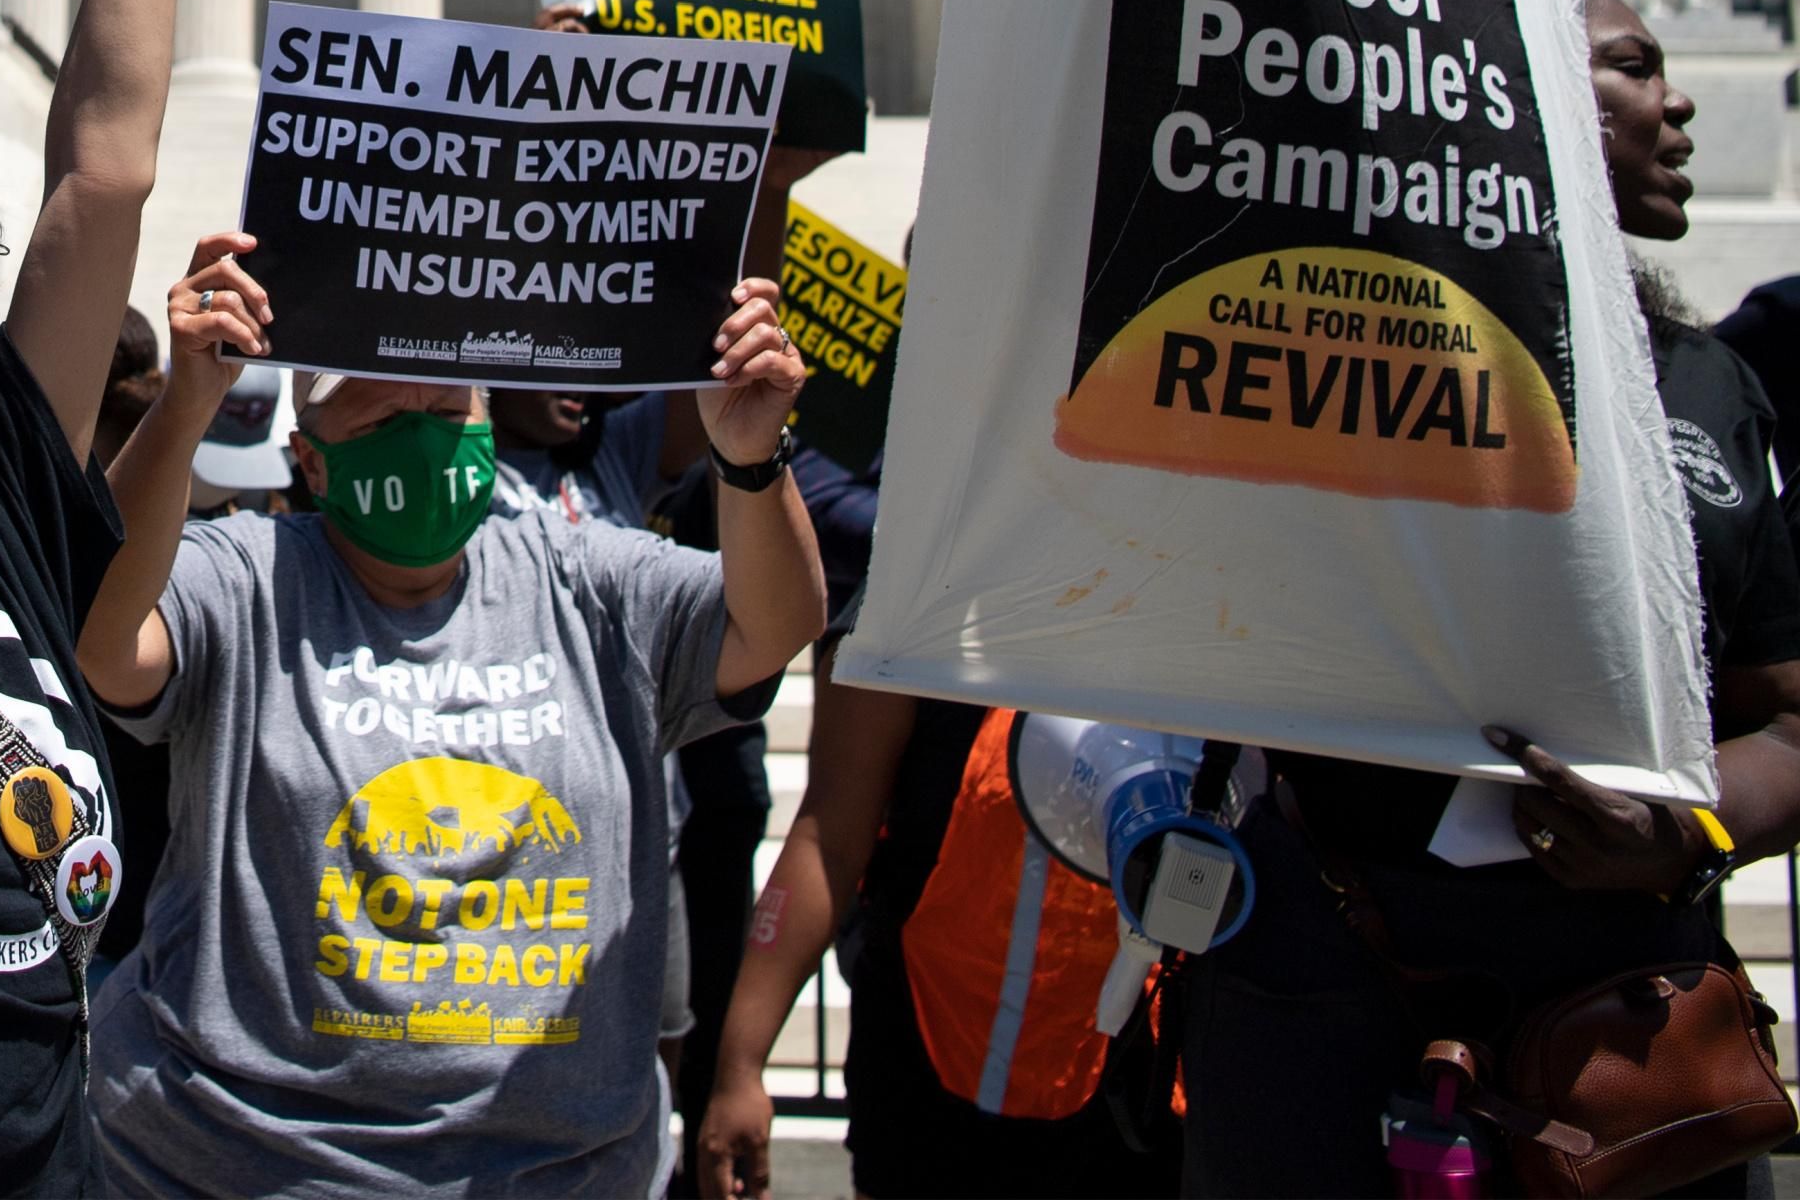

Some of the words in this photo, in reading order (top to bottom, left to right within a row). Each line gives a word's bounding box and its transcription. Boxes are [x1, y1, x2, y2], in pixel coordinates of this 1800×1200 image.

[676, 2, 825, 55] FOREIGN
[269, 27, 421, 98] SEN.
[446, 44, 778, 118] MANCHIN
[261, 111, 502, 181] SUPPORT
[513, 138, 759, 183] EXPANDED
[1151, 109, 1540, 251] Campaign
[298, 176, 706, 245] UNEMPLOYMENT
[355, 247, 655, 304] INSURANCE
[1259, 258, 1284, 291] A
[1296, 267, 1447, 310] NATIONAL
[379, 336, 458, 352] REPAIRERS
[580, 347, 622, 360] CENTER
[1208, 292, 1292, 336] CALL
[1304, 307, 1367, 344] FOR
[1377, 316, 1478, 355] MORAL
[1152, 330, 1508, 451] REVIVAL
[325, 645, 557, 702] FORWARD
[315, 866, 454, 931] NOT
[458, 877, 592, 932] ONE
[315, 933, 449, 983] STEP
[453, 942, 592, 987] BACK
